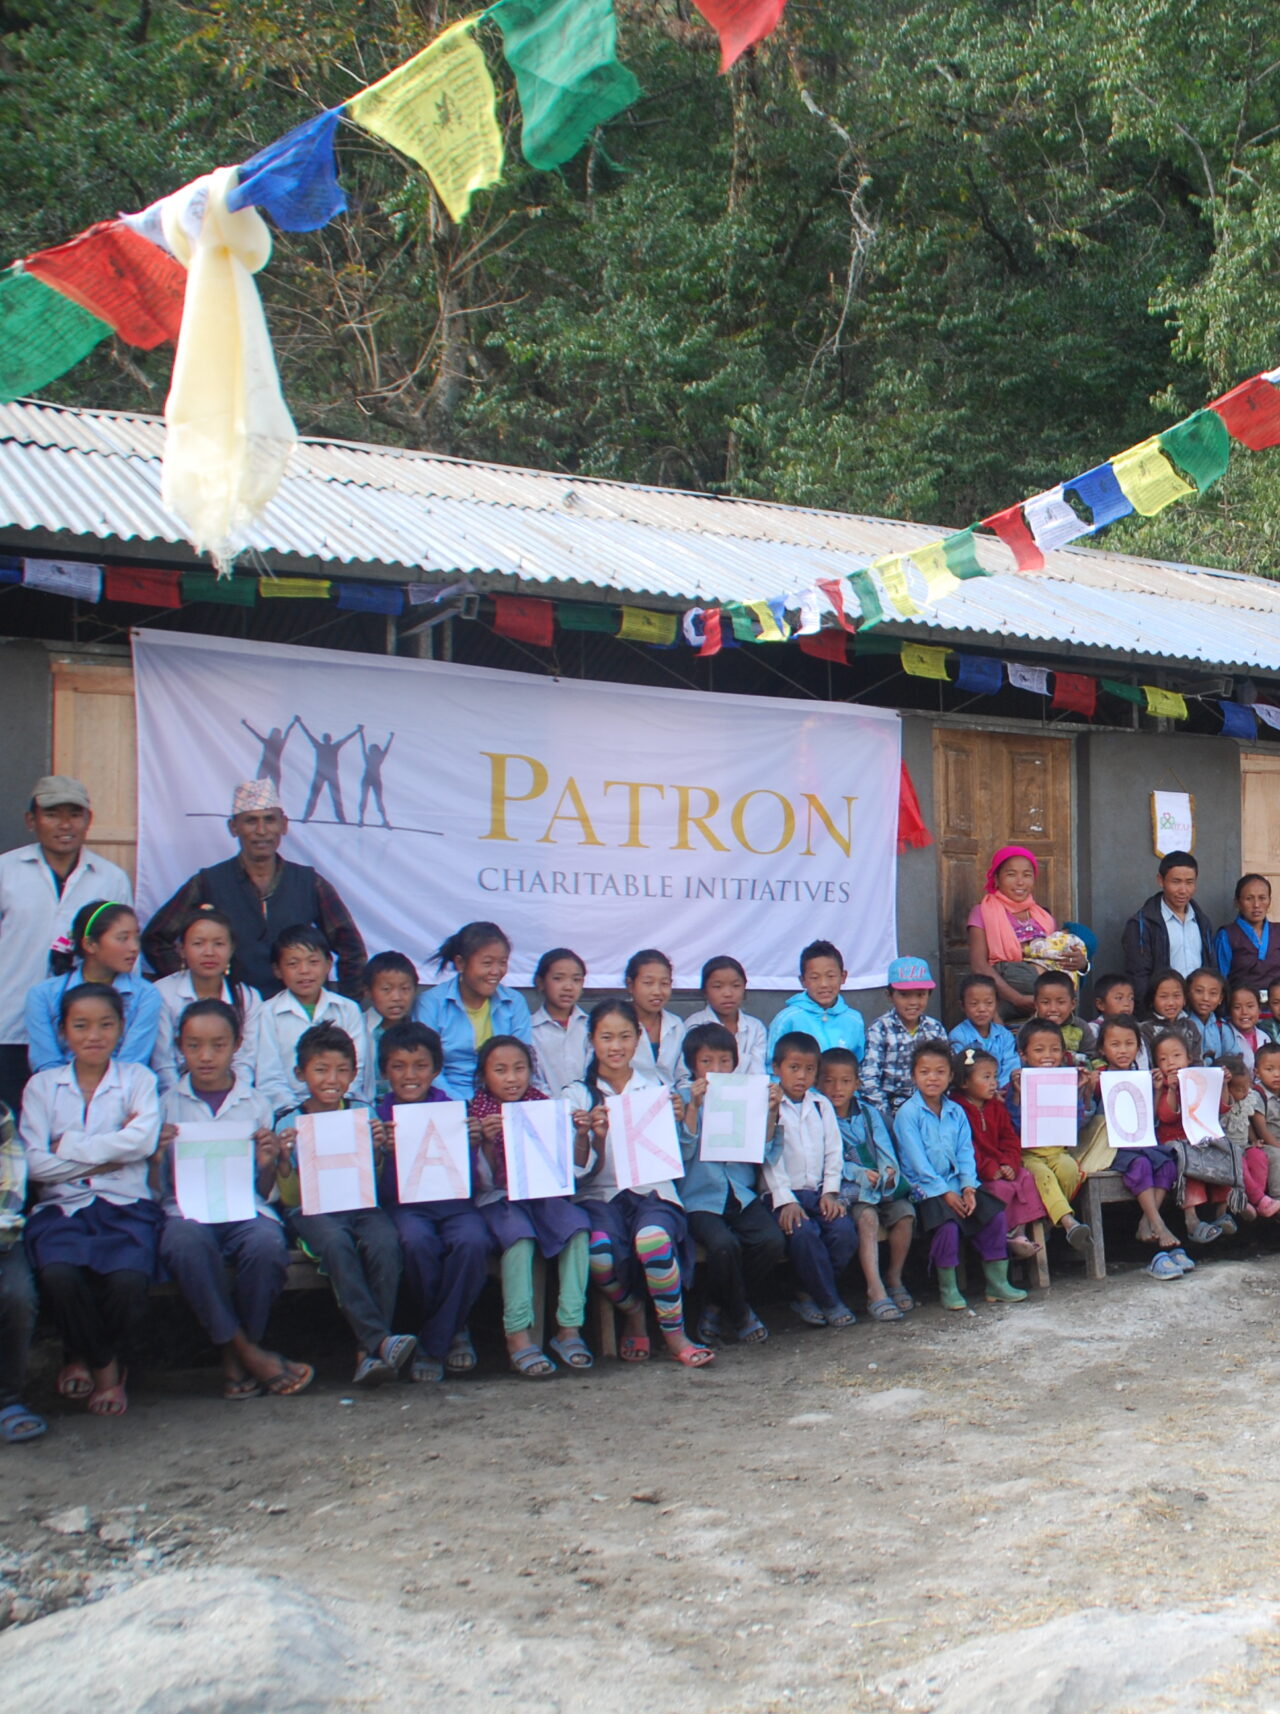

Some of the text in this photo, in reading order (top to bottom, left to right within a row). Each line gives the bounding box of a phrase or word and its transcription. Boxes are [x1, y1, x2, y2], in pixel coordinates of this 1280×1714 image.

[477, 751, 858, 858] PATRON
[478, 867, 850, 904] CHARITABLE INITIATIVES
